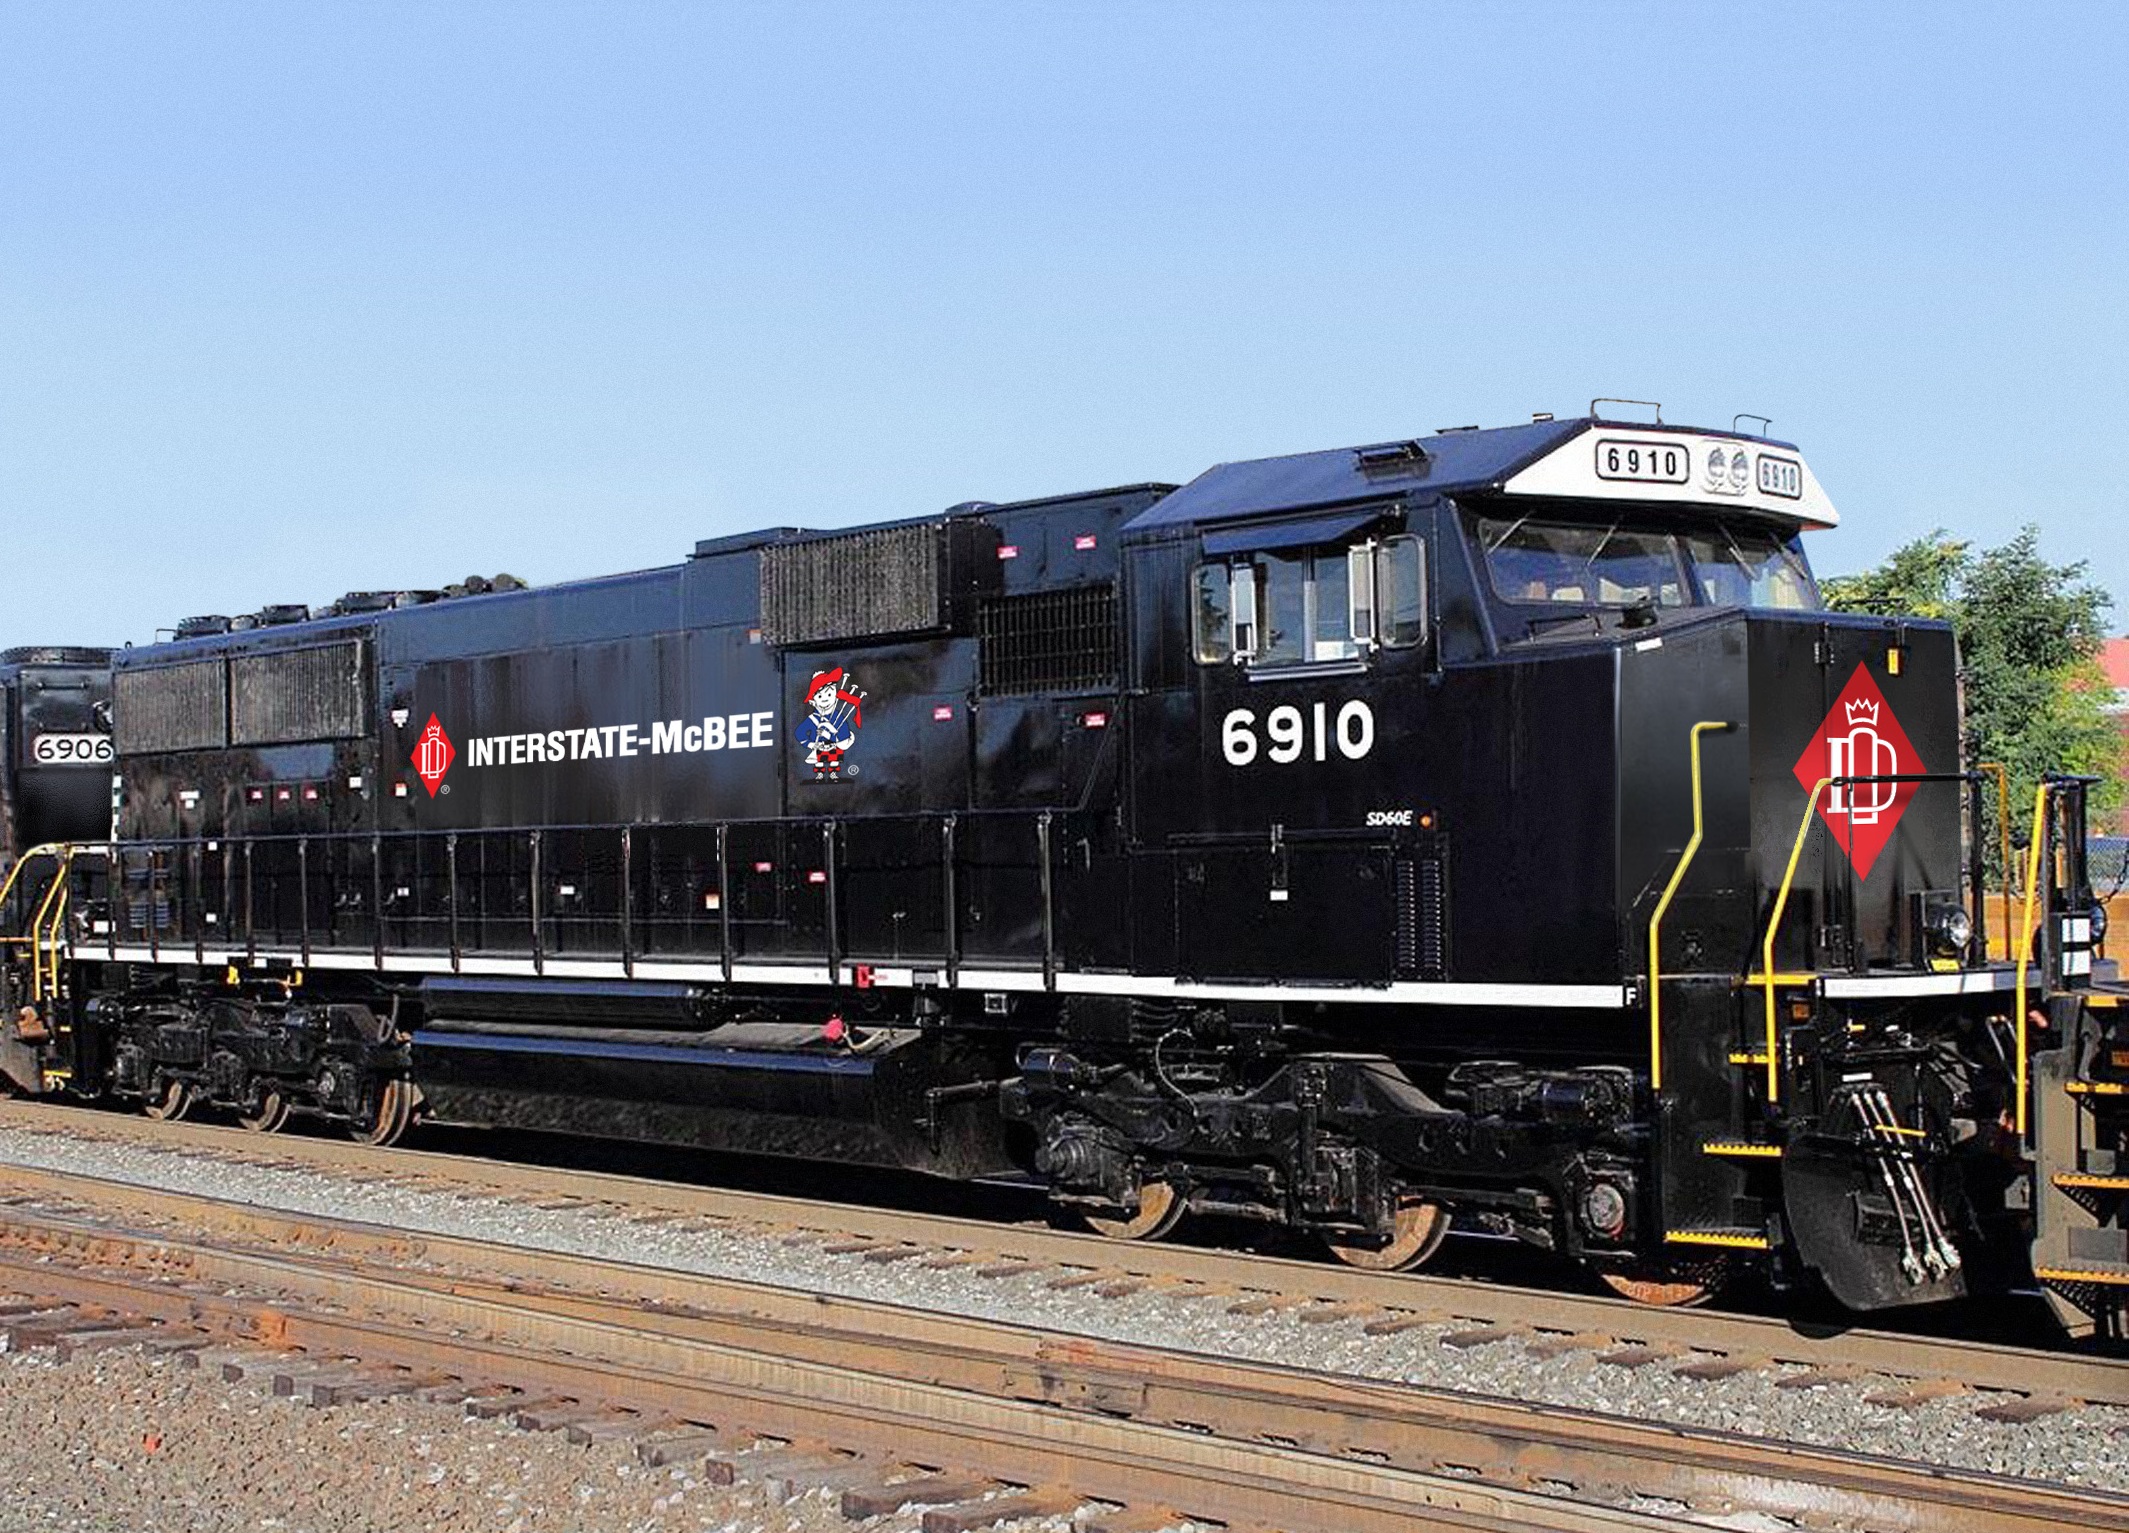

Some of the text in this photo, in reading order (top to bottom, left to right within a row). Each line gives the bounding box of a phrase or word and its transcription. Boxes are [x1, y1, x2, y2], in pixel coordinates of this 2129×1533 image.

[1608, 448, 1677, 476] 6910
[1763, 462, 1796, 493] 6910
[467, 711, 774, 767] INTERSTATE-McBEE
[1222, 699, 1375, 766] 6910
[37, 739, 114, 759] 6906
[1366, 810, 1413, 827] SD60E
[1626, 987, 1637, 1005] F
